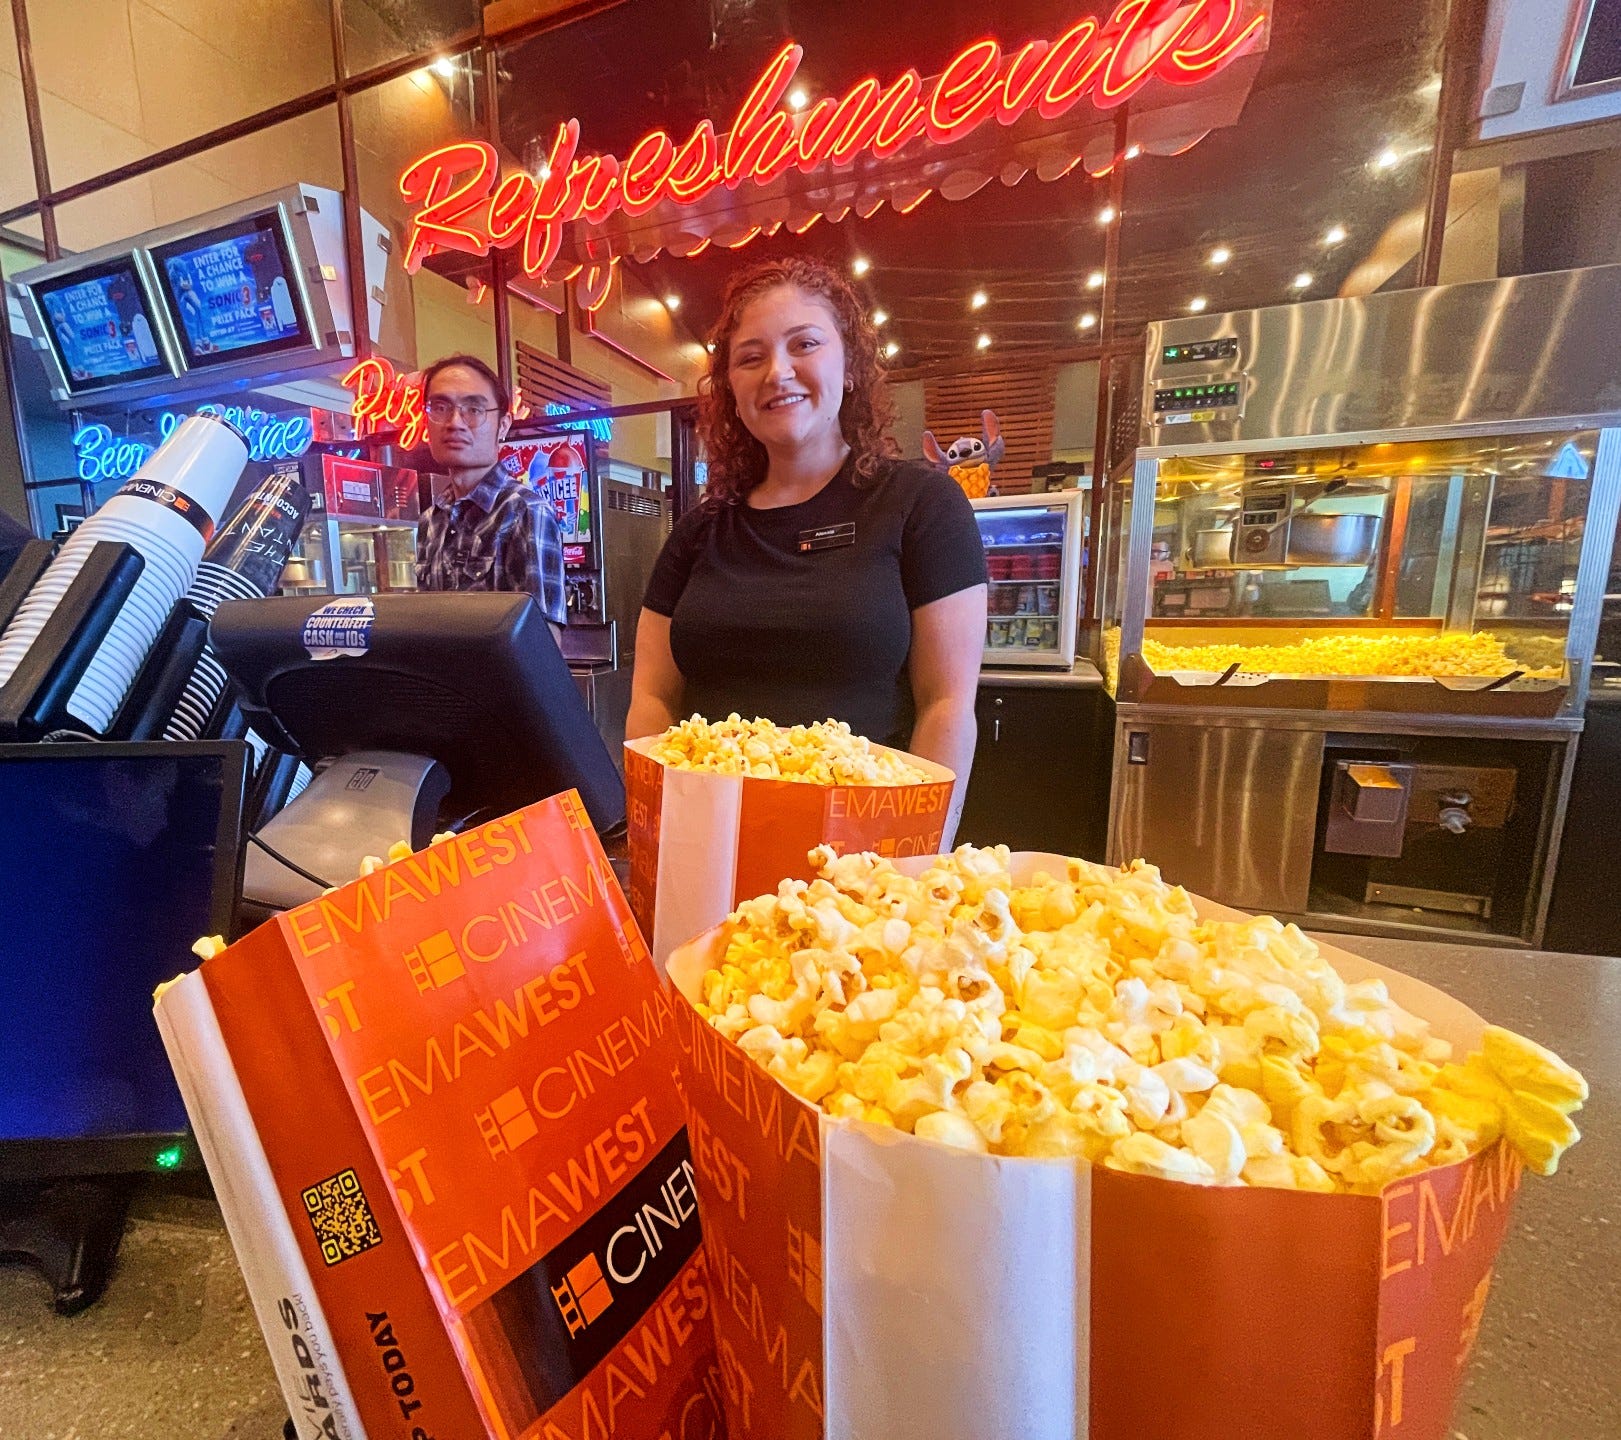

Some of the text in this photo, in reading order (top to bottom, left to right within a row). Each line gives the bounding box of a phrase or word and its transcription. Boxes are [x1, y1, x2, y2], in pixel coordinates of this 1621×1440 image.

[400, 0, 1265, 275] Refreshments
[193, 246, 239, 268] ENTER FOR
[198, 258, 243, 280] A CHANCE
[201, 280, 214, 292] TO
[235, 307, 257, 319] PACK
[73, 425, 148, 480] Beer
[551, 479, 577, 500] ICEE
[306, 616, 369, 629] COUNTERFEIT
[323, 606, 367, 615] WE CHECK
[304, 629, 334, 646] CASH
[829, 784, 949, 819] EMAWEST
[287, 813, 534, 958] EMAWEST
[461, 857, 621, 963] CINEMA
[357, 951, 596, 1126] EMAWEST
[431, 1097, 657, 1305] EMAWEST
[309, 1331, 328, 1362] you
[365, 1311, 422, 1420] TODAY
